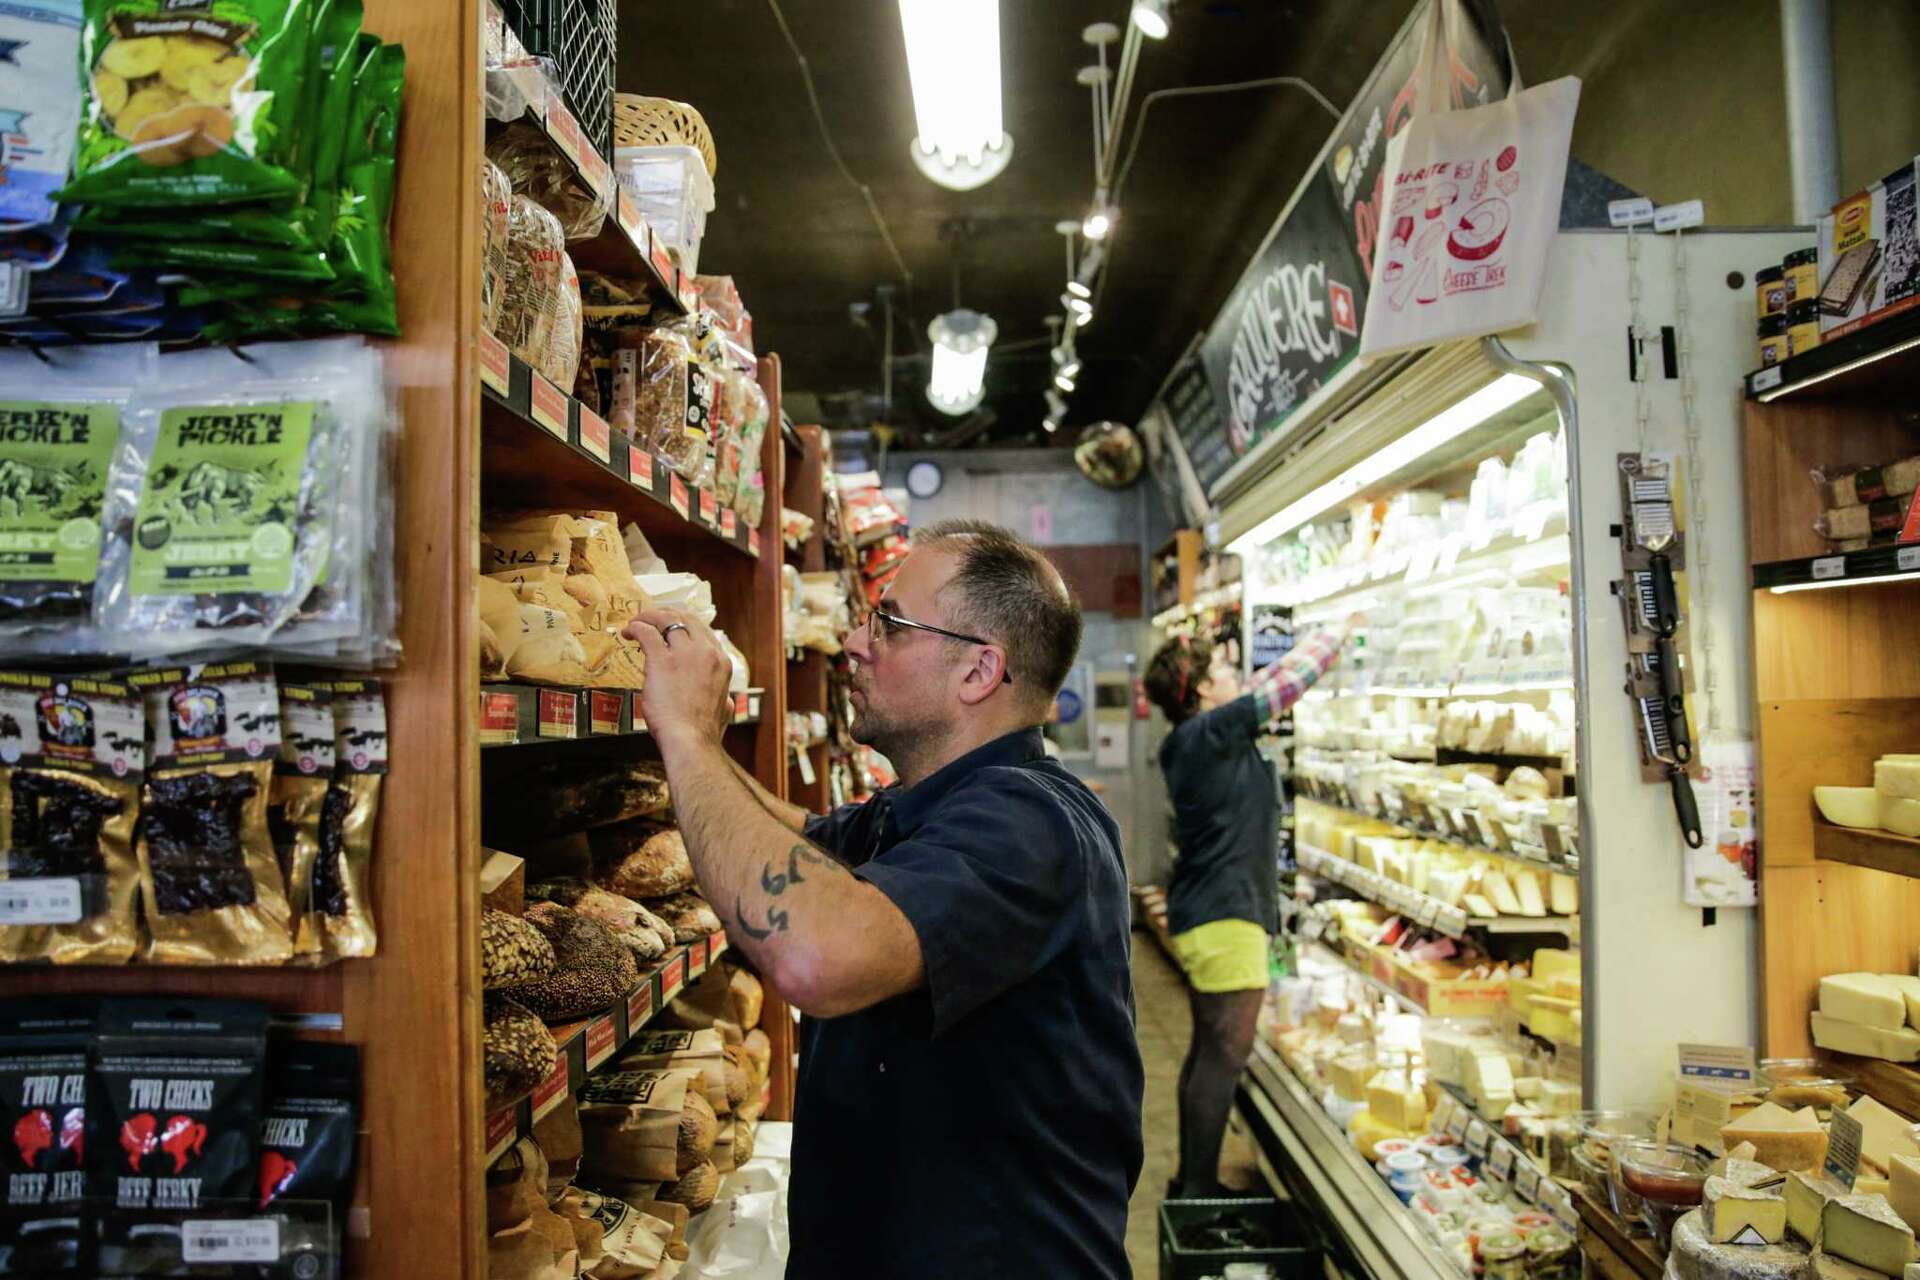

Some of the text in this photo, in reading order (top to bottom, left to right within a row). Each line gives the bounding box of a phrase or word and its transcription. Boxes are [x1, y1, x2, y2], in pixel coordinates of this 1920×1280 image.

[0, 410, 89, 427] ERK'N
[0, 425, 91, 445] ICKLE
[177, 427, 283, 448] PICKLE
[22, 1075, 60, 1107] TWO
[129, 1079, 215, 1110] TWO CHICKS
[263, 1117, 309, 1148] HICKS
[8, 1171, 84, 1204] BEEF JER
[116, 1176, 202, 1208] BEEF JERKY
